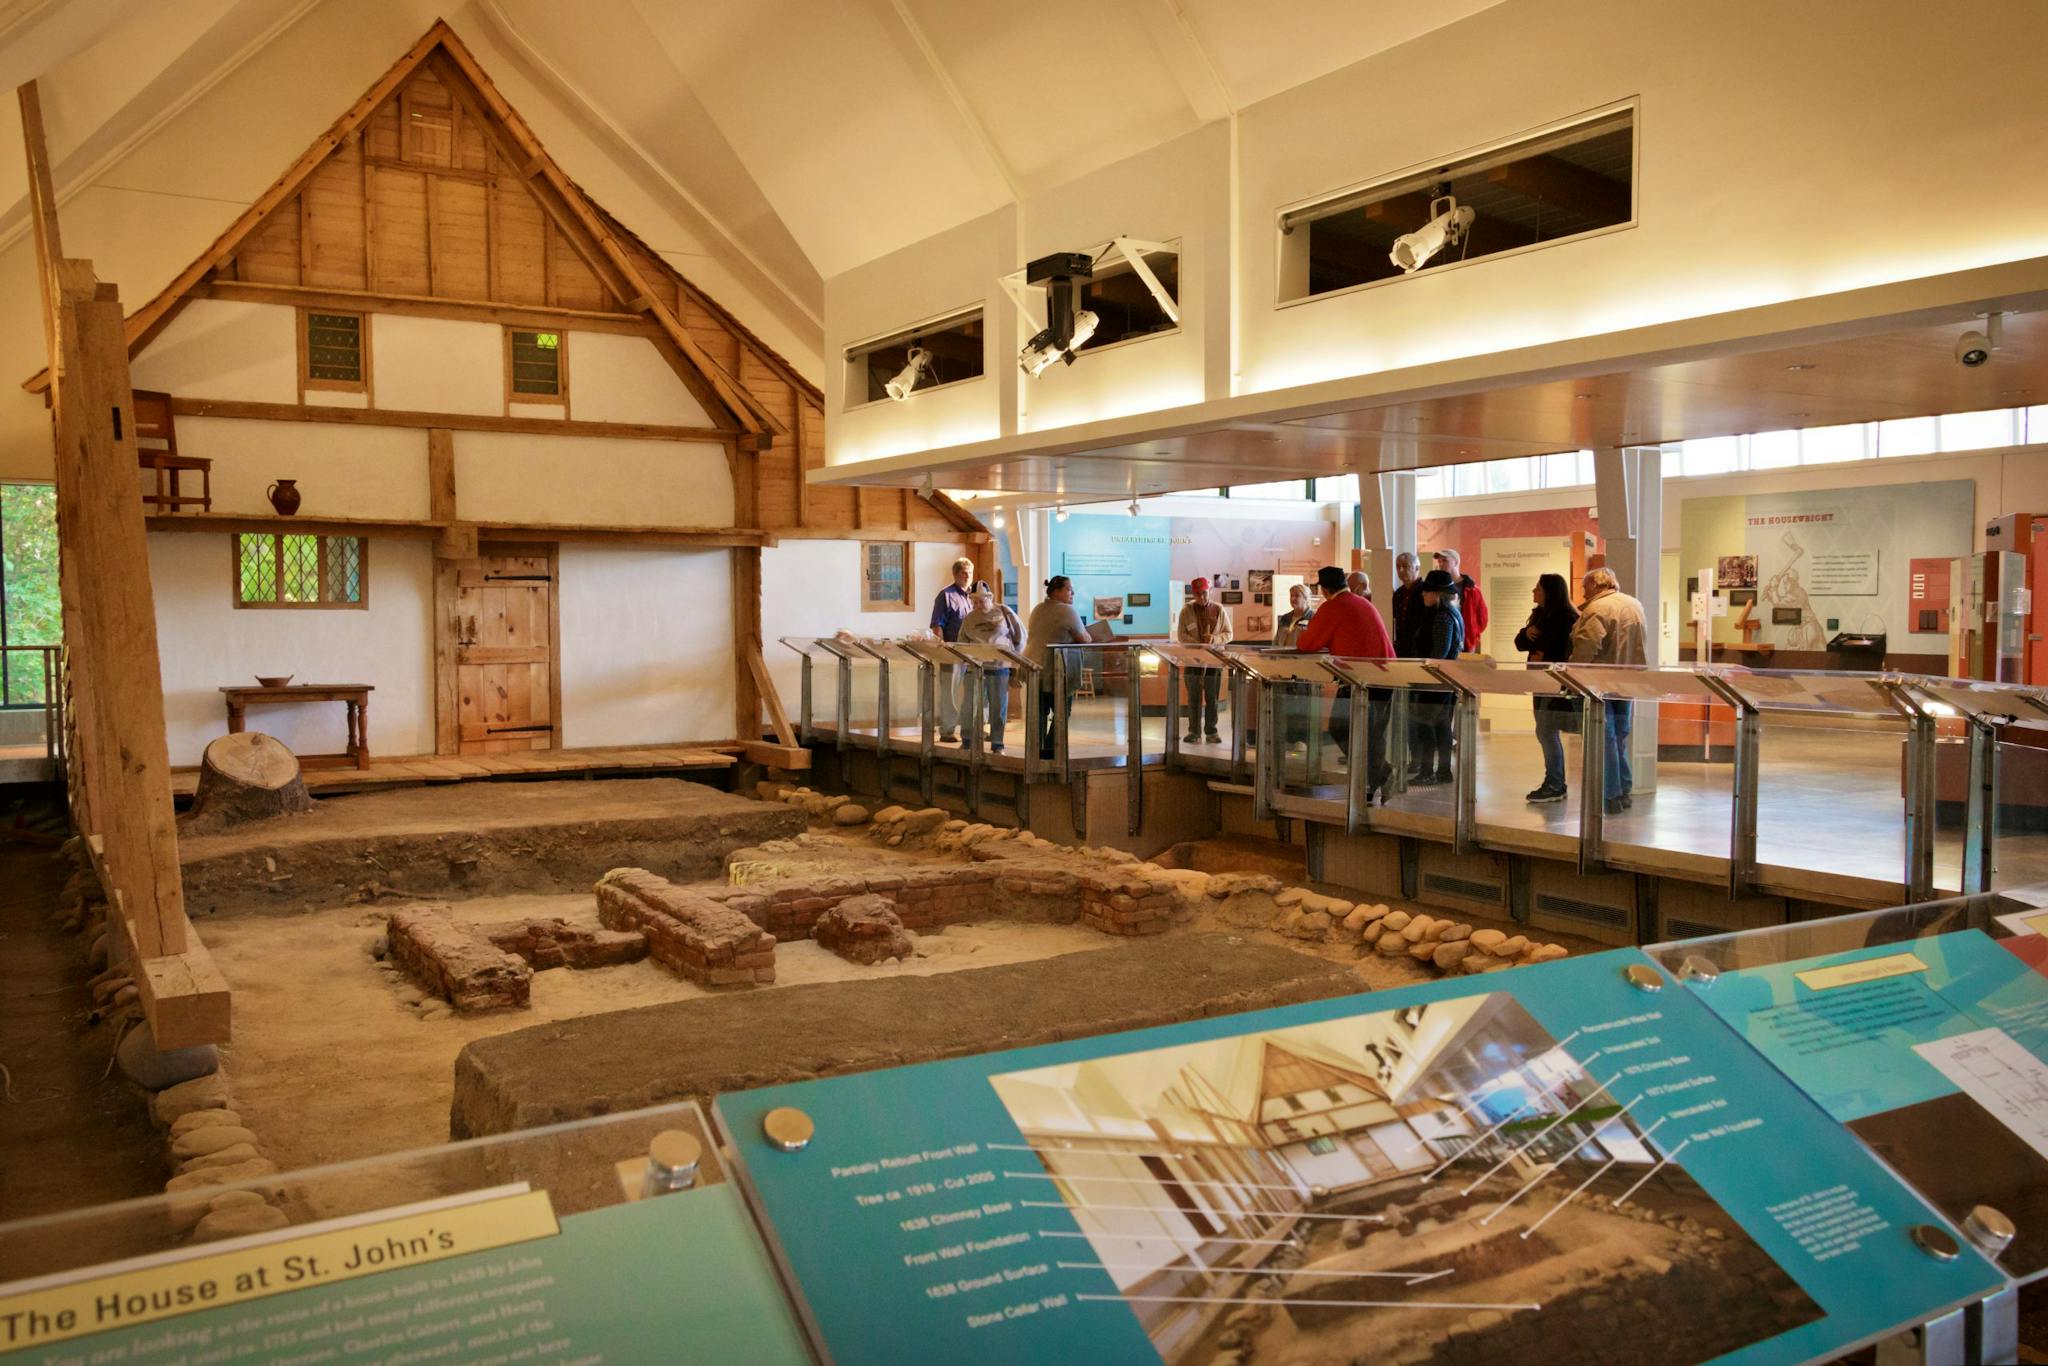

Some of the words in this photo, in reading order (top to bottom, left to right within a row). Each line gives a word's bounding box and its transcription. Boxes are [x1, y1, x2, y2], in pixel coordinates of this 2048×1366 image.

[921, 1147, 954, 1162] Front
[953, 1142, 979, 1155] Wall
[855, 1193, 884, 1207] Tree
[2, 1307, 78, 1343] The
[95, 1278, 219, 1322] House
[234, 1266, 271, 1293] at
[283, 1256, 330, 1283] St.
[344, 1228, 456, 1270] John's
